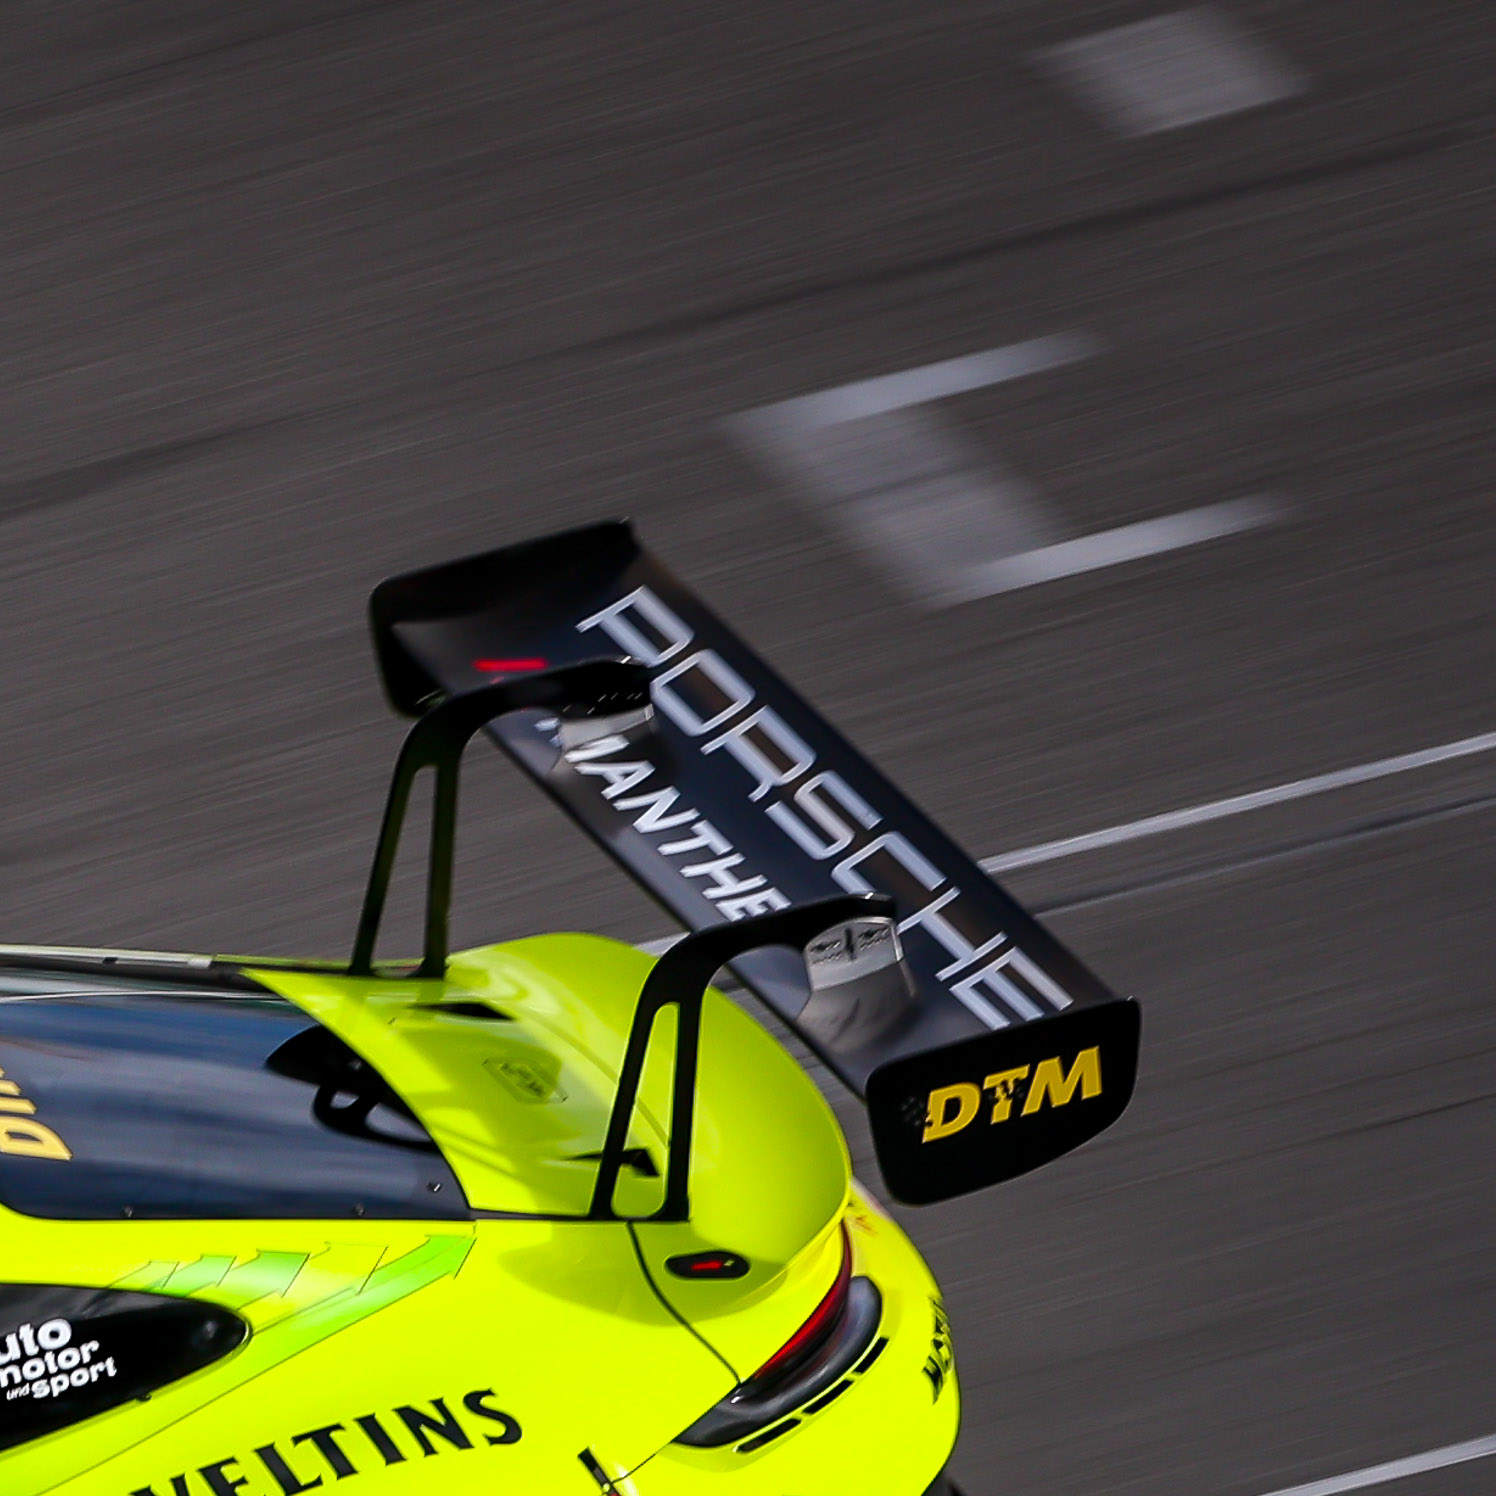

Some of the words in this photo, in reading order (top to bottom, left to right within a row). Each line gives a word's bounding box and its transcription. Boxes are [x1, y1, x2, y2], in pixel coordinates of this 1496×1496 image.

[575, 585, 1073, 1030] PORSCHE
[922, 1046, 1103, 1143] DTM
[6, 1384, 30, 1401] und
[31, 1356, 117, 1400] sport
